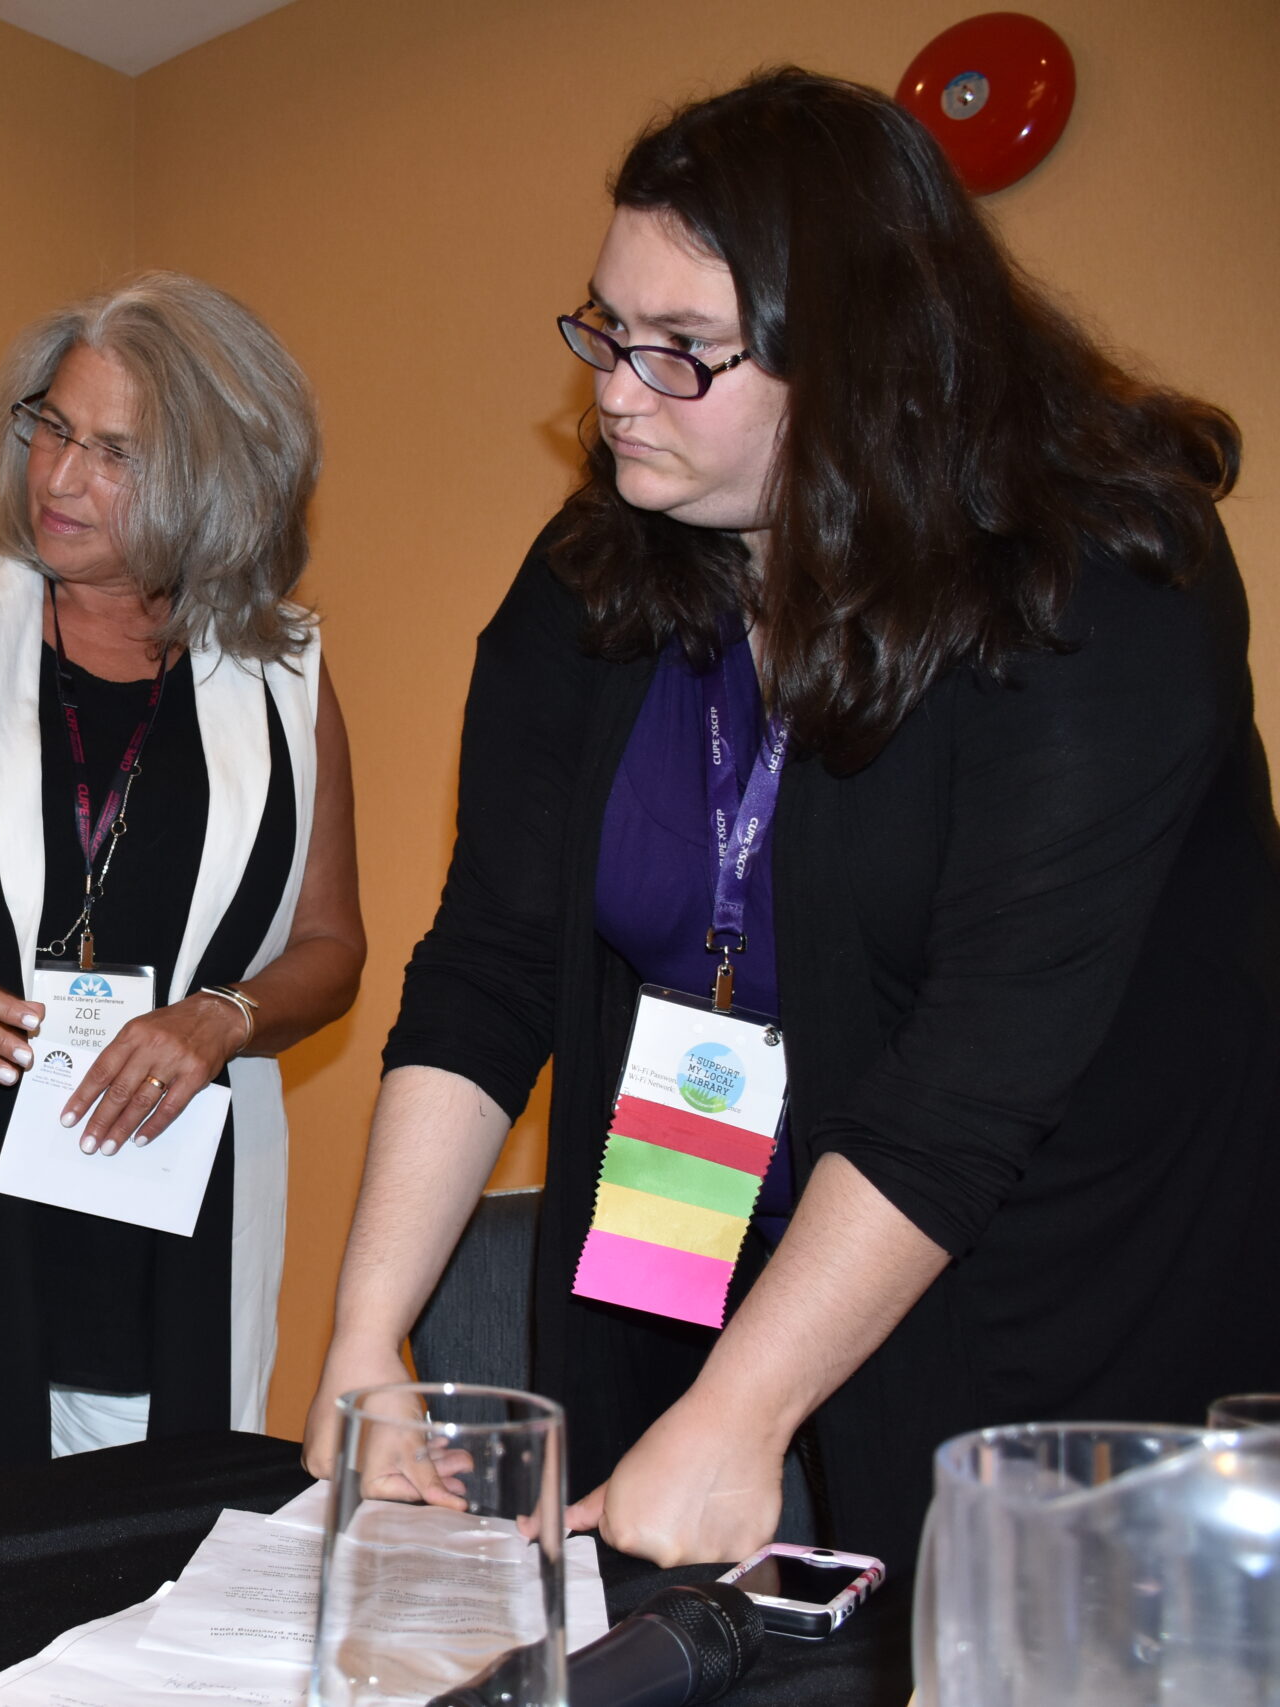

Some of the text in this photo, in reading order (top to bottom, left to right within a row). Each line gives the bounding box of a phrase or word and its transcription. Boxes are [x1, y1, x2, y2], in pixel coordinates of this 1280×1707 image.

[77, 783, 90, 816] CUPE
[743, 817, 759, 847] CUPE
[75, 996, 94, 1004] Library
[95, 997, 125, 1005] Conference
[75, 1007, 101, 1020] ZOE
[68, 1025, 107, 1037] Magnus
[71, 1038, 103, 1048] CUPE BC
[631, 1063, 649, 1076] Wi-Fi
[696, 1056, 741, 1080] SUPPORT
[628, 1072, 647, 1085] Wi-Fi
[687, 1063, 735, 1089] MY LOCAL
[687, 1073, 730, 1097] LIBRARY
